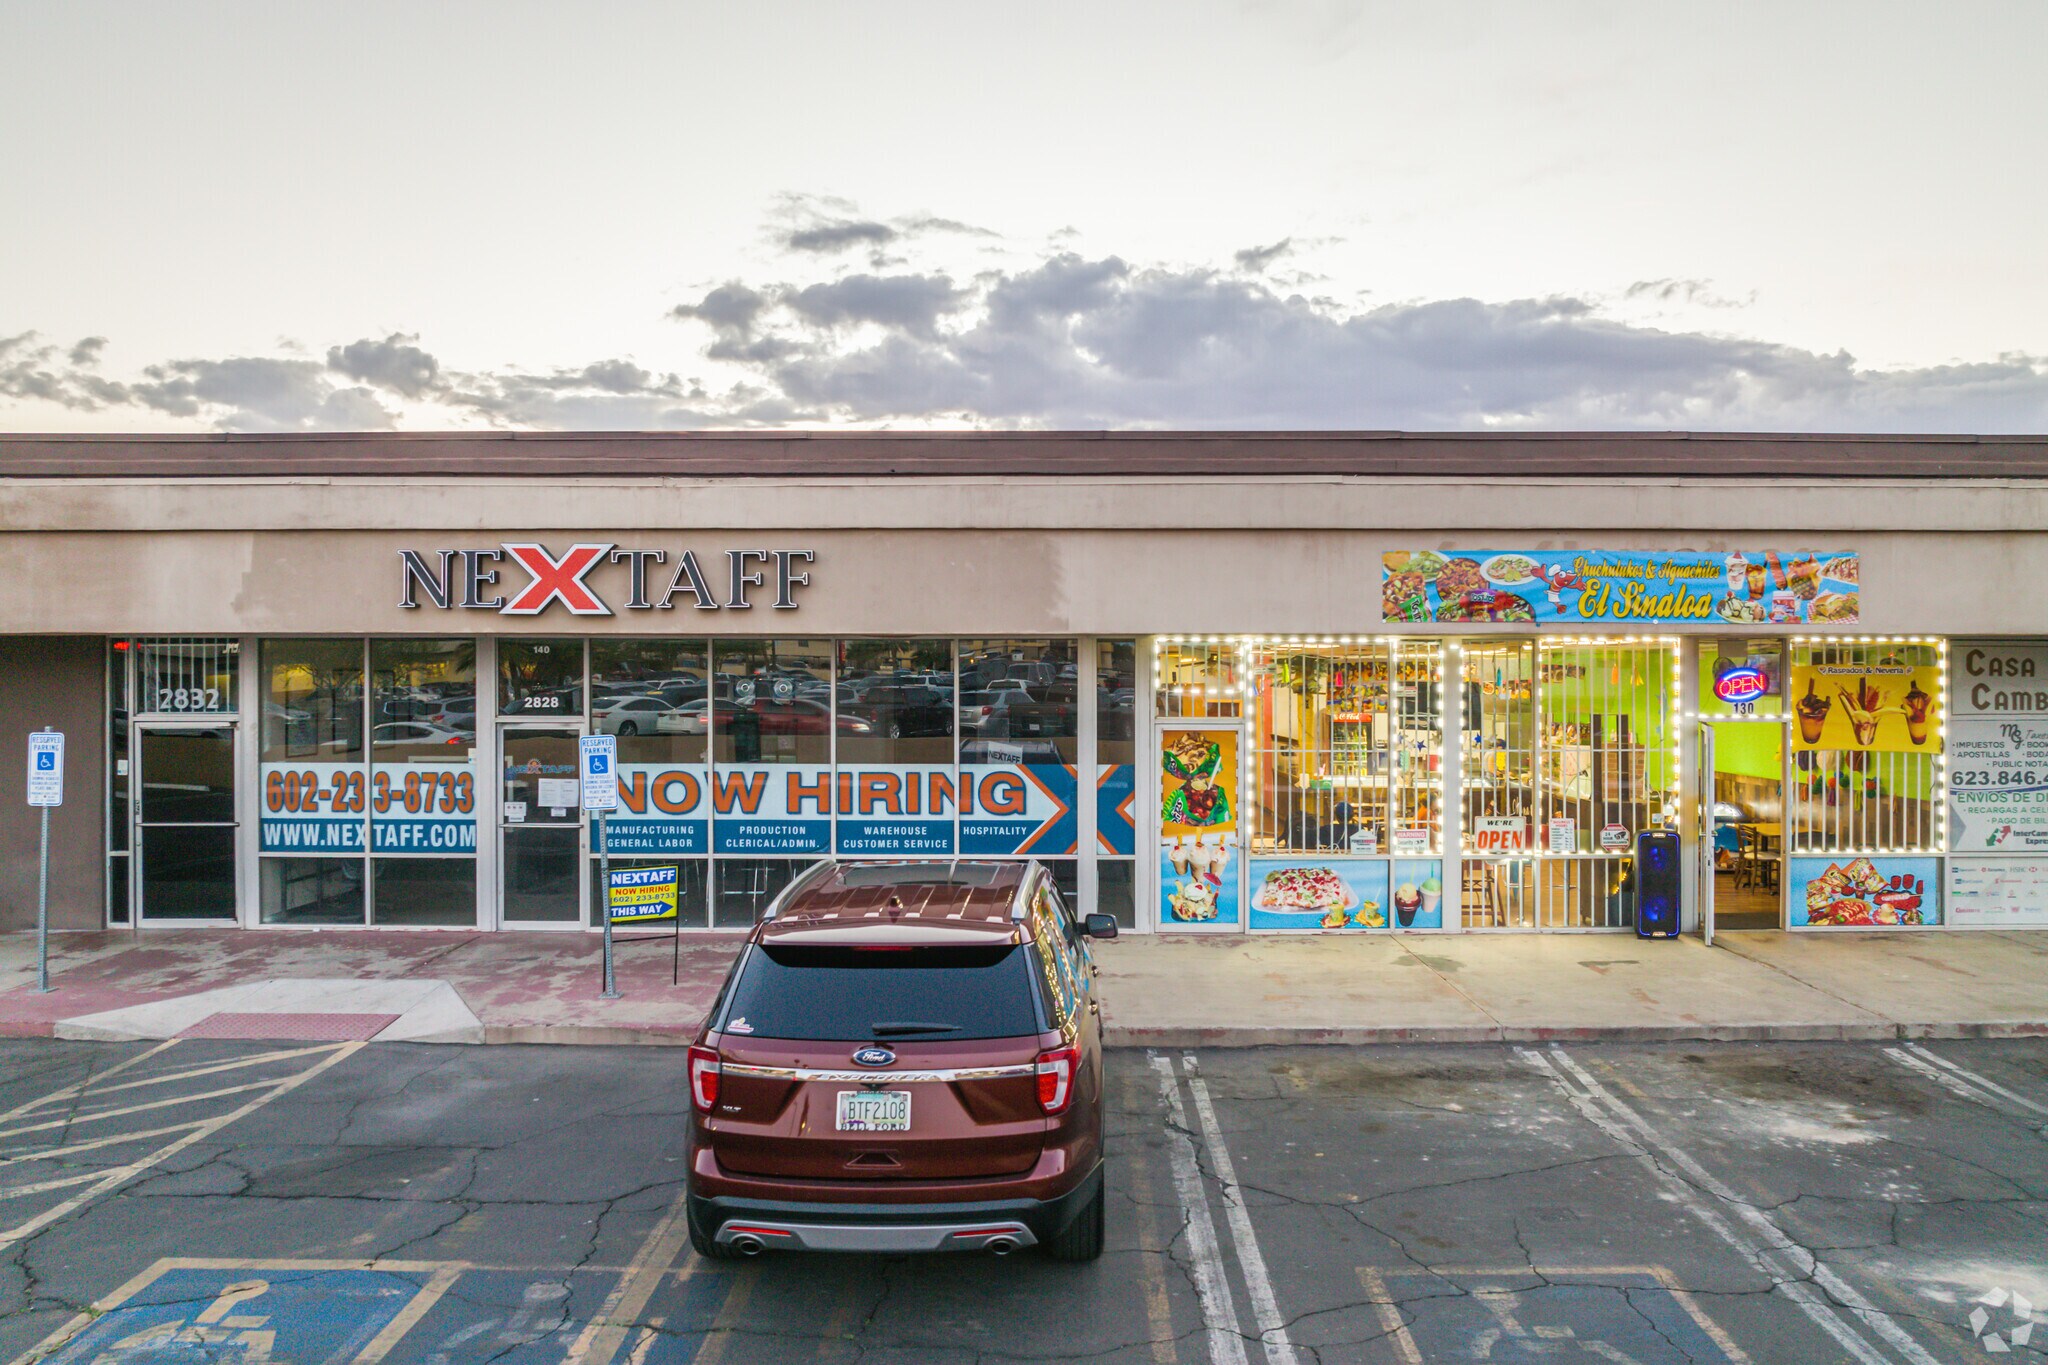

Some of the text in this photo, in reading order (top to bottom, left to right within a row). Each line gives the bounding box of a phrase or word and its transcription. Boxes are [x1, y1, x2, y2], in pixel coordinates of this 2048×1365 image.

[1645, 560, 1657, 579] &
[1658, 559, 1720, 586] Aguachiles
[397, 543, 816, 615] NEXTAFF
[1578, 578, 1712, 618] El Sinaloa
[533, 645, 550, 654] 140
[1828, 667, 1863, 675] Raspados
[1719, 674, 1765, 697] OPEN
[159, 688, 219, 711] 2832
[524, 696, 559, 708] 2828
[1733, 702, 1754, 715] 130
[32, 736, 61, 744] RESERVED
[582, 738, 613, 747] RESERVED
[1956, 741, 2005, 749] IMPUESTOS
[584, 746, 612, 754] PARKING
[988, 750, 1021, 764] NEXTAFF
[1992, 760, 2023, 768] PUBLIC
[266, 770, 475, 814] 602-233-8733
[604, 770, 769, 815] NOW
[786, 771, 1027, 815] HIRING
[1957, 792, 2008, 803] ENVIOS
[2012, 792, 2031, 803] DE
[1968, 806, 2018, 814] RECARGAS
[263, 823, 476, 847] WWW.NEXTAFF.COM
[606, 825, 694, 835] MANUFACTURING
[739, 825, 806, 835] PRODUCTION
[864, 826, 927, 836] WAREHOUSE
[963, 826, 1027, 836] HOSPITALITY
[607, 838, 693, 848] GENERAL LABOR
[726, 838, 820, 848] CLERICAL/ADMIN.
[843, 839, 948, 849] CUSTOMER SERVICE
[1477, 830, 1522, 849] OPEN
[611, 870, 675, 885] NEXTAFF
[615, 885, 670, 896] NOW HIRING
[636, 892, 675, 902] 233-8733
[611, 904, 663, 917] THIS WAY
[862, 1051, 886, 1062] Ford
[848, 1101, 906, 1120] BTF2108
[841, 1123, 906, 1131] BELL FORD
